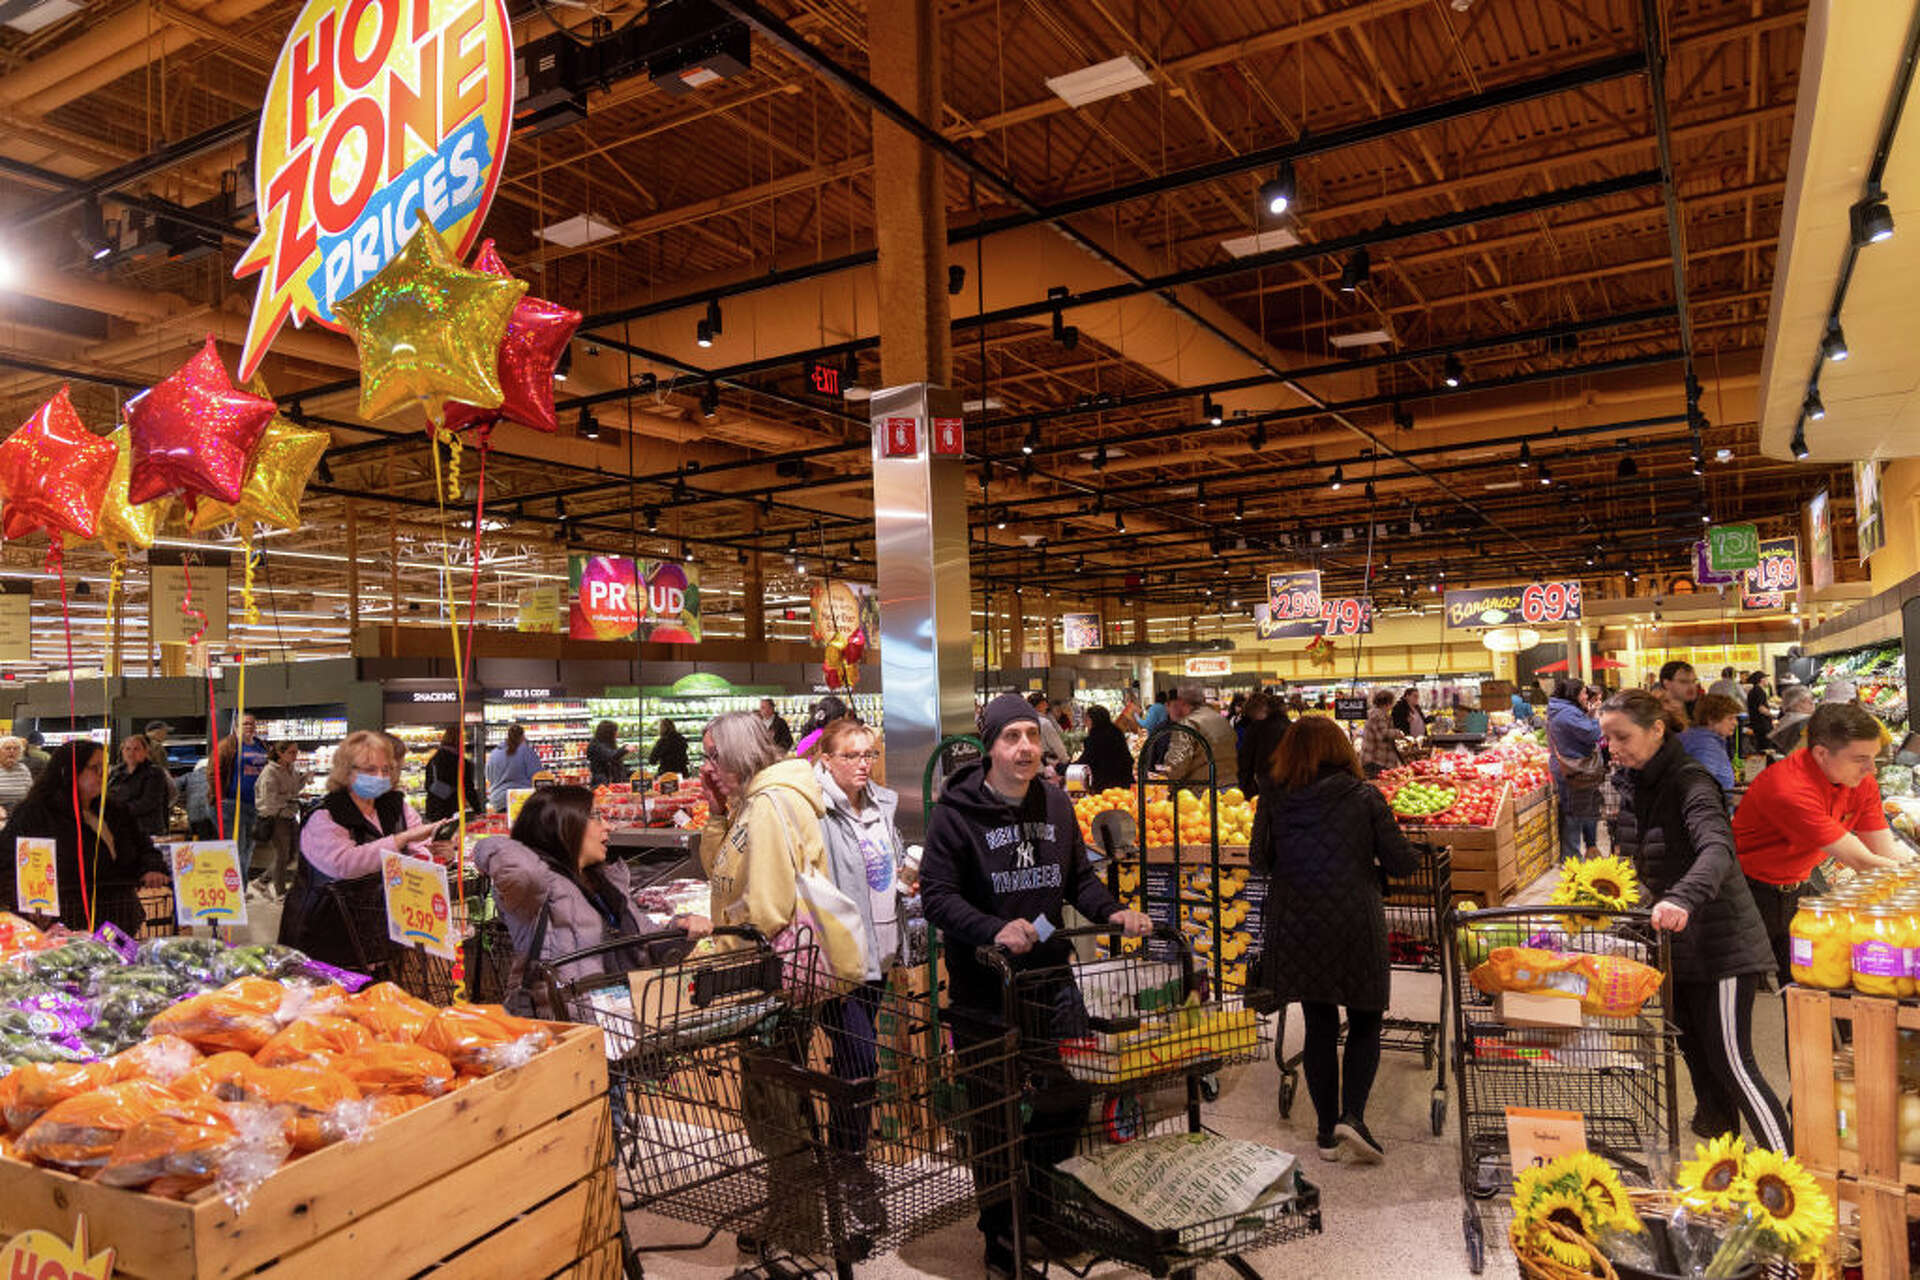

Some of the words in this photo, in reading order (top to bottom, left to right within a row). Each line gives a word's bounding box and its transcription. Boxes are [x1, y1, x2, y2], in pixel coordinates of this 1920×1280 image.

[268, 0, 488, 293] ZONE
[325, 132, 481, 308] PRICES
[814, 365, 839, 395] EXIT
[590, 580, 686, 614] PROUD
[1449, 596, 1520, 625] Bananas
[413, 692, 457, 702] SNACKING
[503, 689, 524, 698] JUICE
[991, 864, 1062, 893] YANKEES
